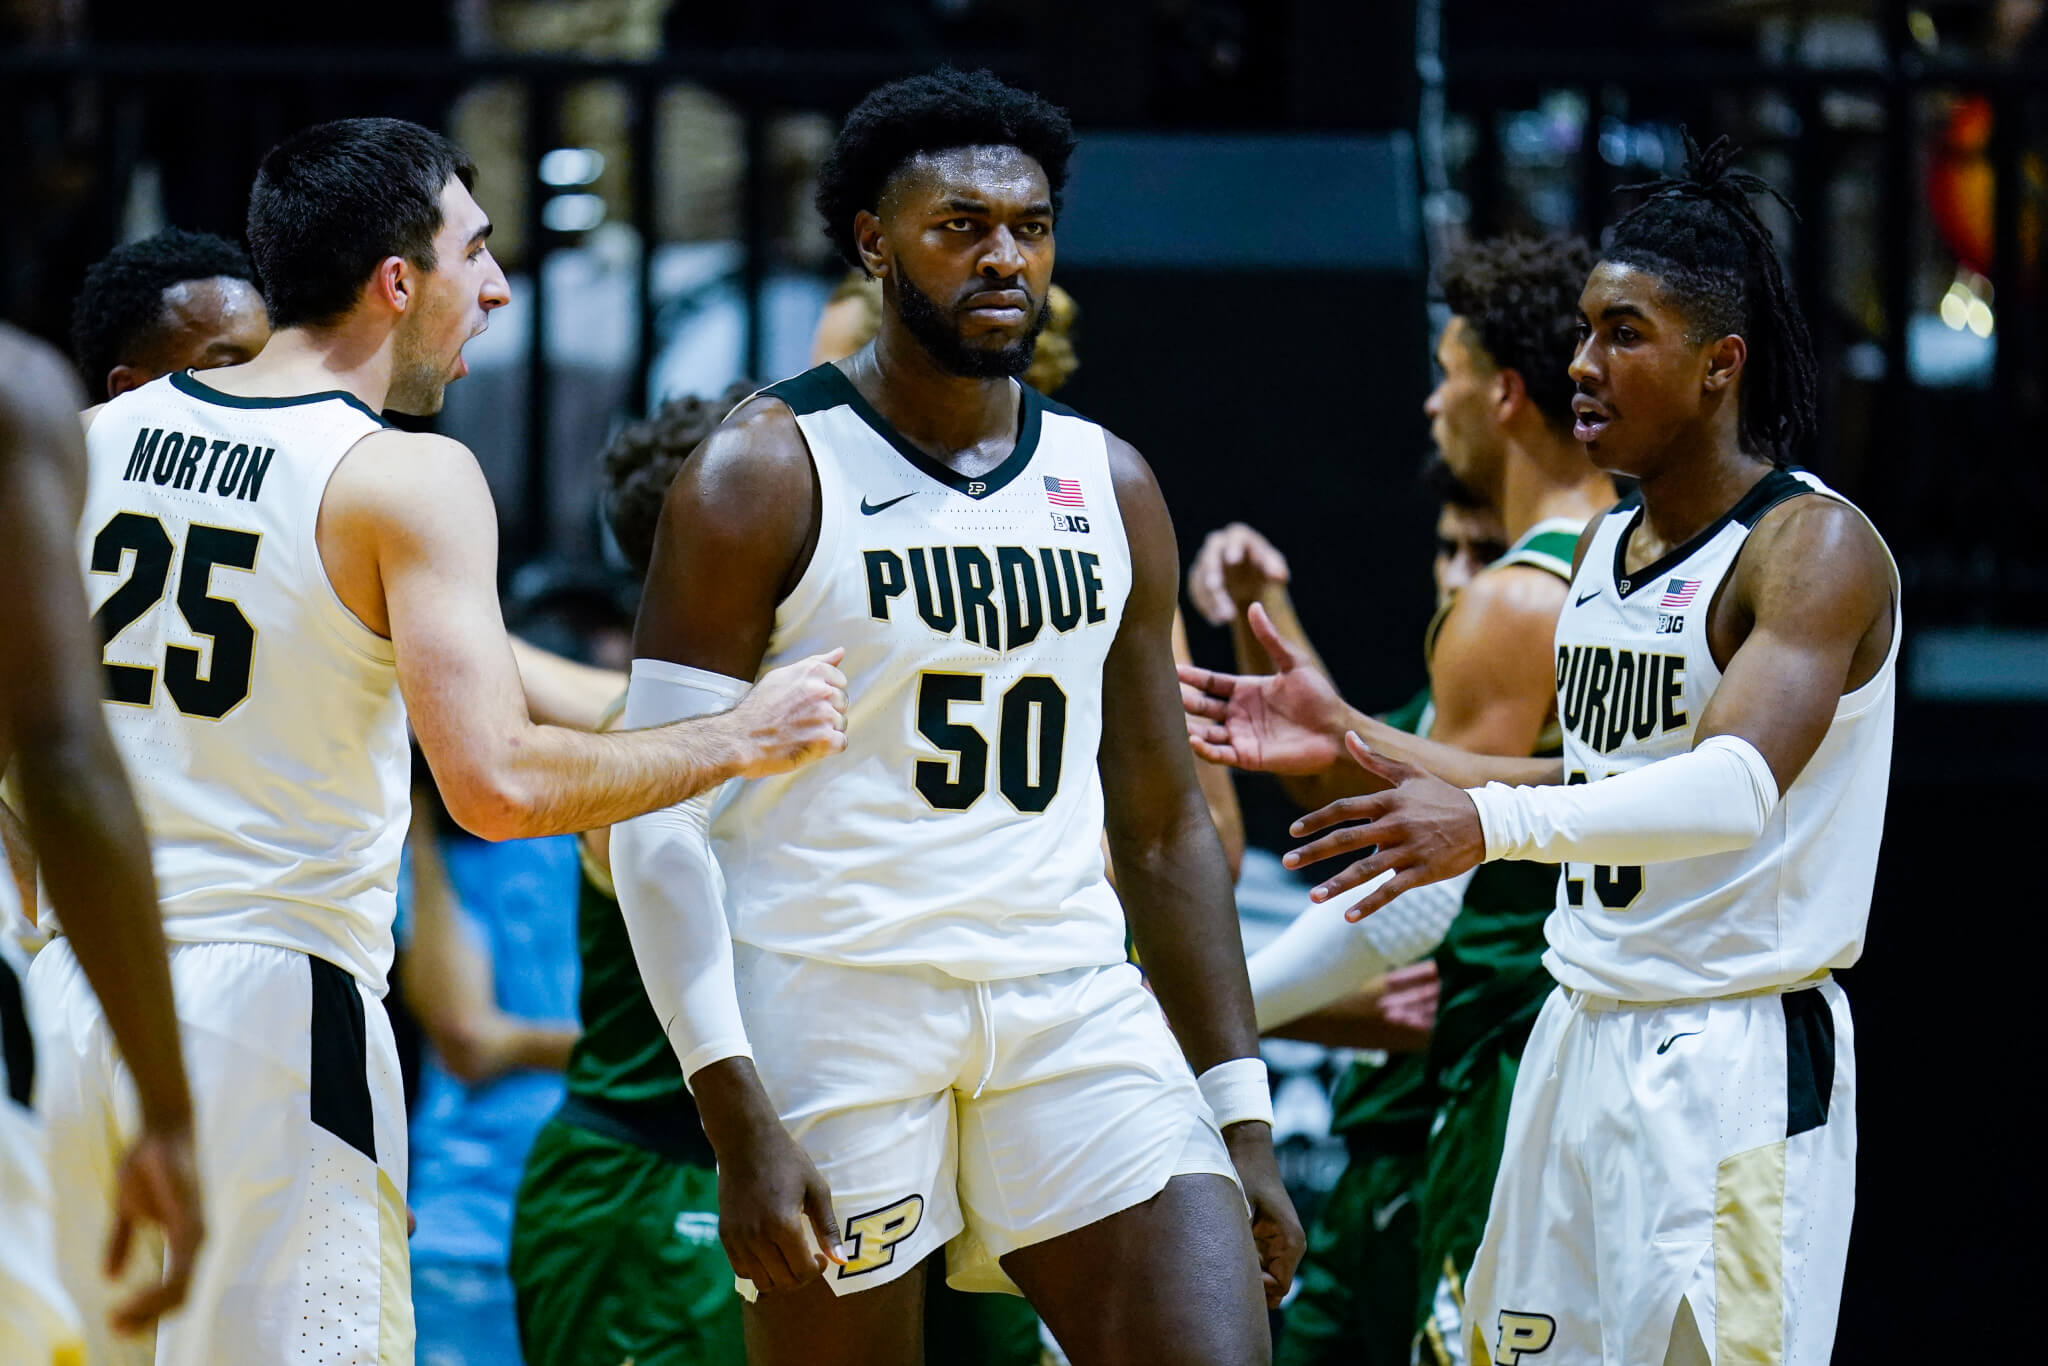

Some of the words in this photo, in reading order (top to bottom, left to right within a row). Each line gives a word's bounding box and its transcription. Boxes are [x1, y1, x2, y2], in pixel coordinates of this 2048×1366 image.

[122, 427, 276, 502] MORTON
[968, 481, 987, 495] P
[88, 508, 264, 722] 25
[860, 545, 1108, 656] PURDUE
[1619, 579, 1632, 594] P
[911, 669, 1069, 815] 50
[837, 1193, 924, 1280] P
[1495, 1309, 1556, 1366] P
